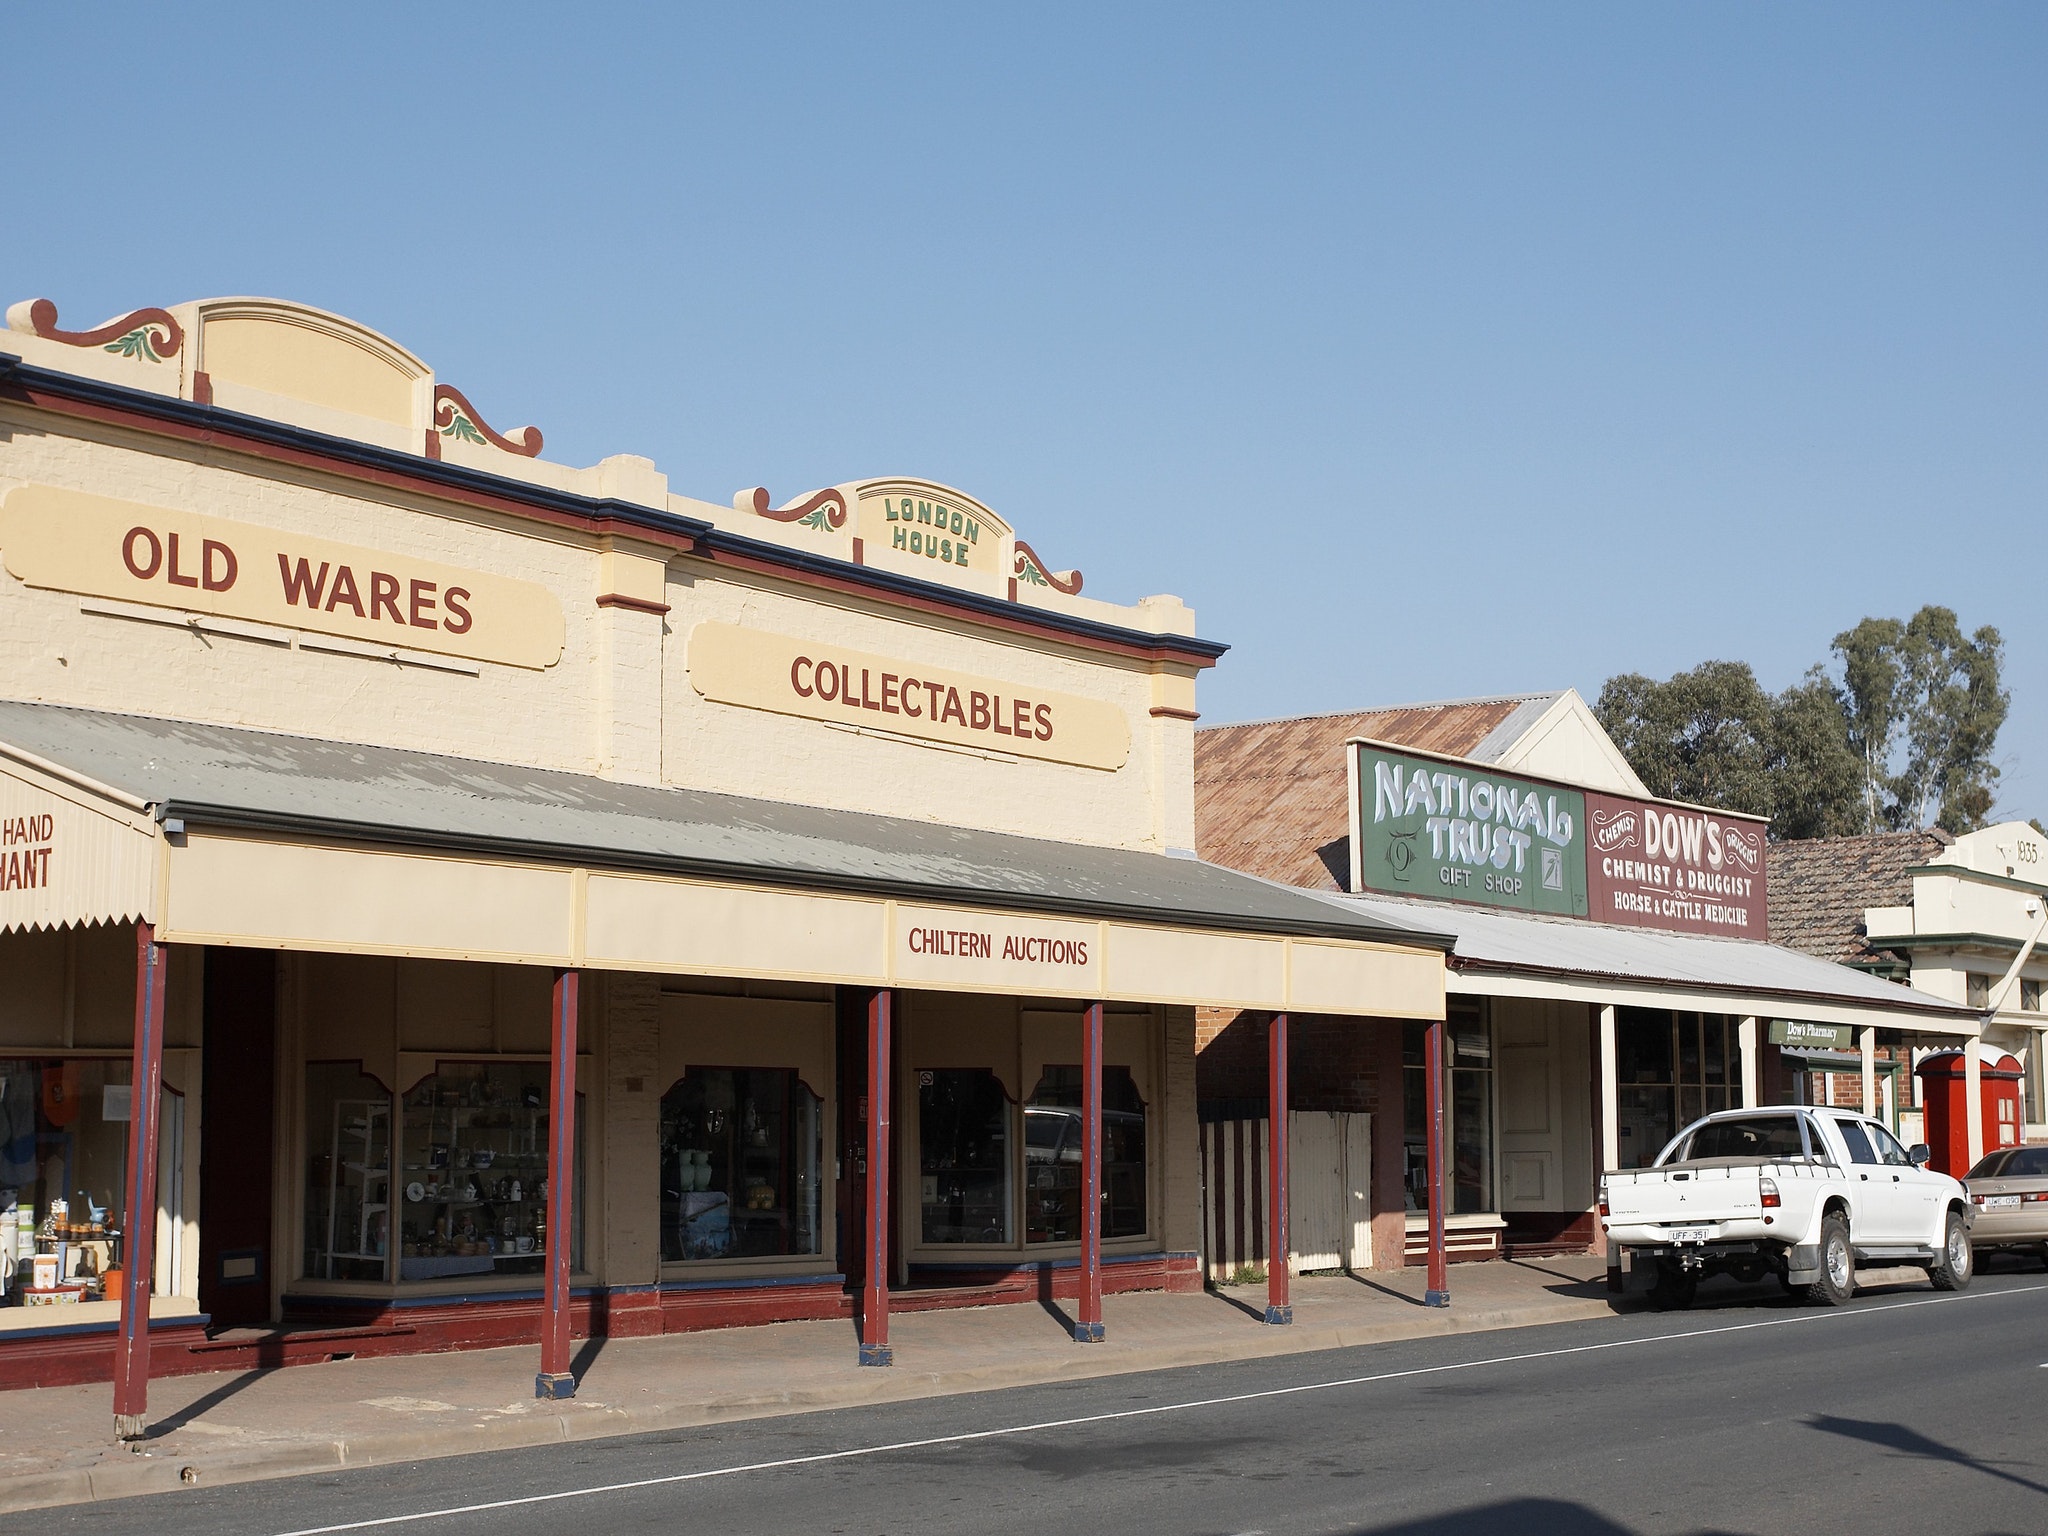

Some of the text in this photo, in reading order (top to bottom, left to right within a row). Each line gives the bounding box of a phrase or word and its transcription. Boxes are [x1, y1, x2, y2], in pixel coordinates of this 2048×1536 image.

[884, 497, 980, 546] LONDON
[892, 524, 970, 567] HOUSE
[121, 526, 474, 635] OLD WARES
[790, 655, 1054, 742] COLLECTABLES
[1374, 760, 1574, 848] NATIONAL
[3, 813, 54, 846] HAND
[1426, 816, 1532, 874] TRUST
[1598, 816, 1636, 845] CHEMIST
[1644, 808, 1723, 869] DOW'S
[1726, 833, 1759, 866] DRUGGIST
[2017, 839, 2038, 864] 1935
[1439, 866, 1523, 896] GIFT SHOP
[1602, 856, 1752, 898] CHEMIST & DRUGGIST
[1613, 891, 1748, 927] HORSE & CATTLE MEDICINE
[908, 927, 1088, 966] CHILTERN AUCTIONS
[1787, 1021, 1806, 1036] Dow's
[1806, 1023, 1838, 1042] Pharmacy
